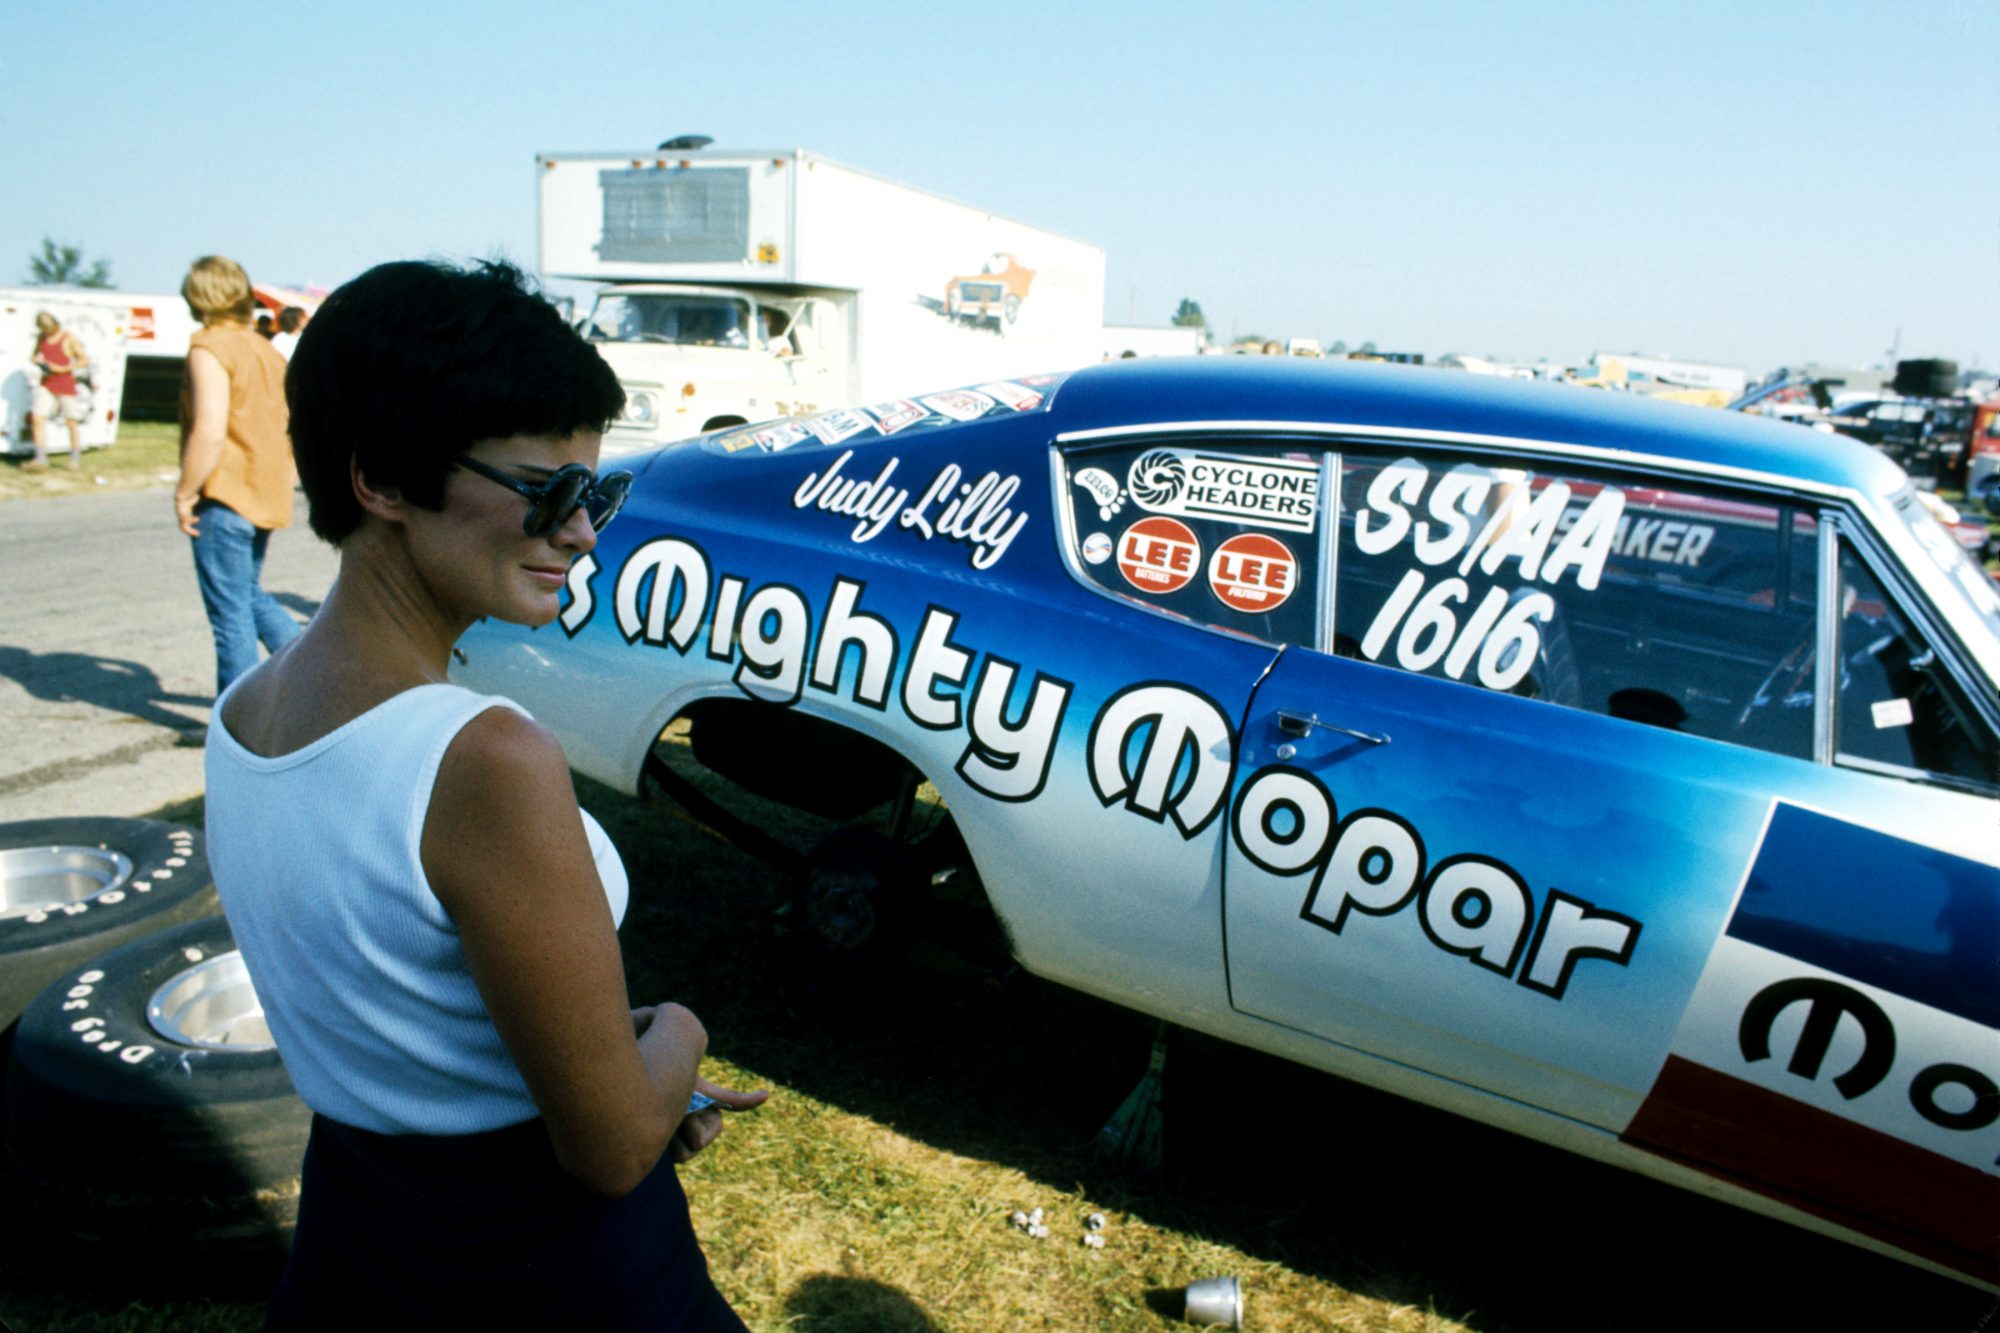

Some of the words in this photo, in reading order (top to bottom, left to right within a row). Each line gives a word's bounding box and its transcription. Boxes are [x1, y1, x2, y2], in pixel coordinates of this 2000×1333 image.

[793, 449, 909, 544] Judy
[900, 463, 1029, 571] Lilly
[1186, 484, 1313, 516] HEADERS
[1191, 464, 1318, 496] CYCLONE
[1124, 536, 1193, 572] LEE
[1355, 457, 1626, 591] SS/AA
[1216, 554, 1289, 590] LEE
[1360, 567, 1555, 691] 1616
[613, 535, 1075, 802] Mighty
[1086, 680, 1643, 1001] Mopar
[62, 969, 106, 1011] 500
[1738, 976, 2000, 1166] Mo
